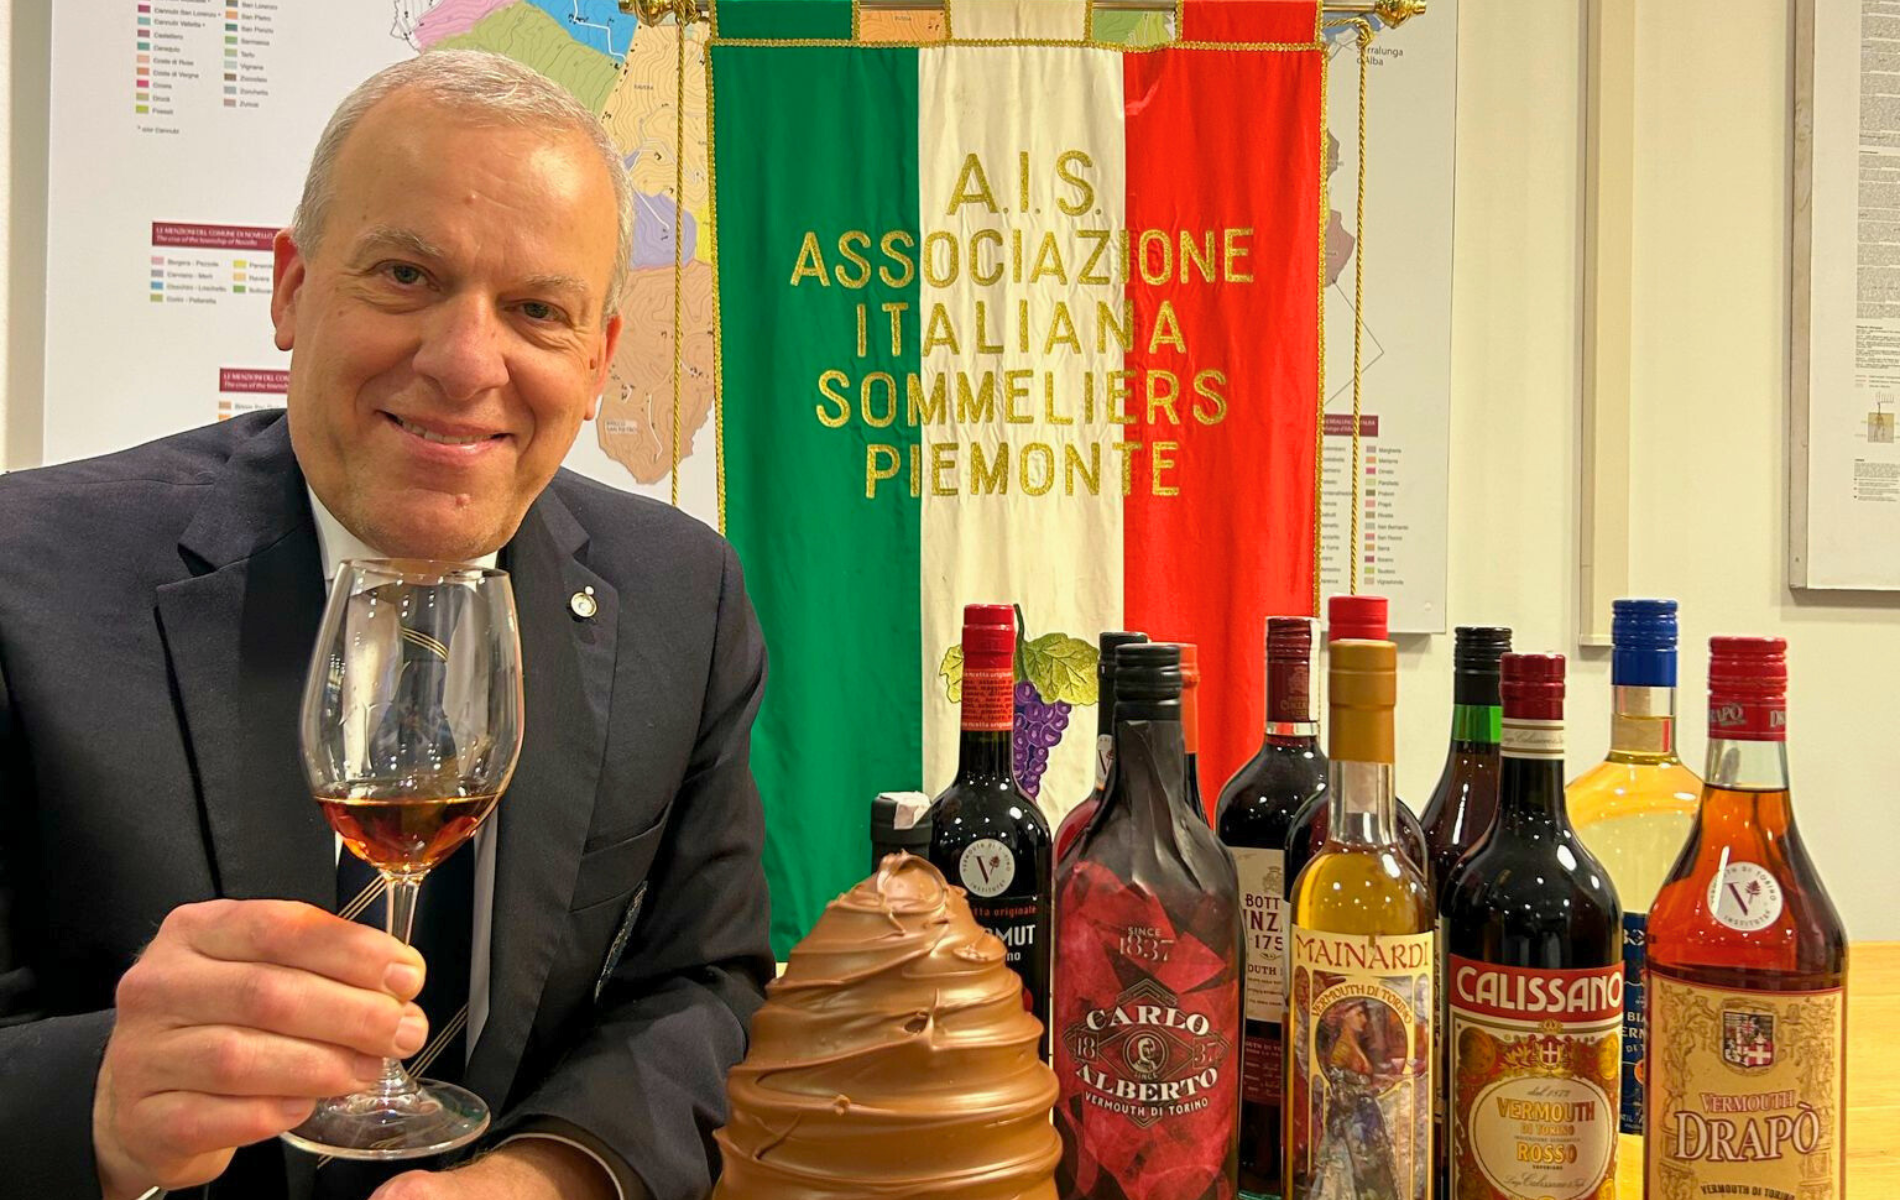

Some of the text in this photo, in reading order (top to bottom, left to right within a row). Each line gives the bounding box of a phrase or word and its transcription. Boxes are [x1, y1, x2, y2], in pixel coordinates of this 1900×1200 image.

[946, 149, 1102, 217] A.I.S.
[789, 227, 1255, 288] ASSOCIAZIONE
[857, 299, 1187, 358] ITALIANA
[816, 368, 1228, 428] SOMMELIERS
[865, 441, 1180, 499] PIEMONTE
[1245, 893, 1280, 910] BOTT
[1128, 927, 1161, 937] SINCE
[1243, 909, 1283, 932] INZ
[1296, 934, 1430, 970] MAINARDI
[1247, 964, 1277, 976] OUTH
[1311, 984, 1365, 1017] VERMOUTH
[1366, 985, 1378, 996] DI
[1381, 989, 1413, 1024] TORINO
[1456, 965, 1624, 1013] CALISSANO
[1086, 1005, 1209, 1035] CARLO
[1076, 1064, 1217, 1101] ALBERTO
[1085, 1091, 1208, 1117] VERMOUTH DI TORINO
[1496, 1096, 1595, 1123] VERMOUTH
[1700, 1089, 1795, 1114] VERMOUTH
[1674, 1101, 1820, 1163] DRAPÒ
[1516, 1141, 1578, 1164] ROSSO
[1701, 1184, 1750, 1195] VERMOUTH
